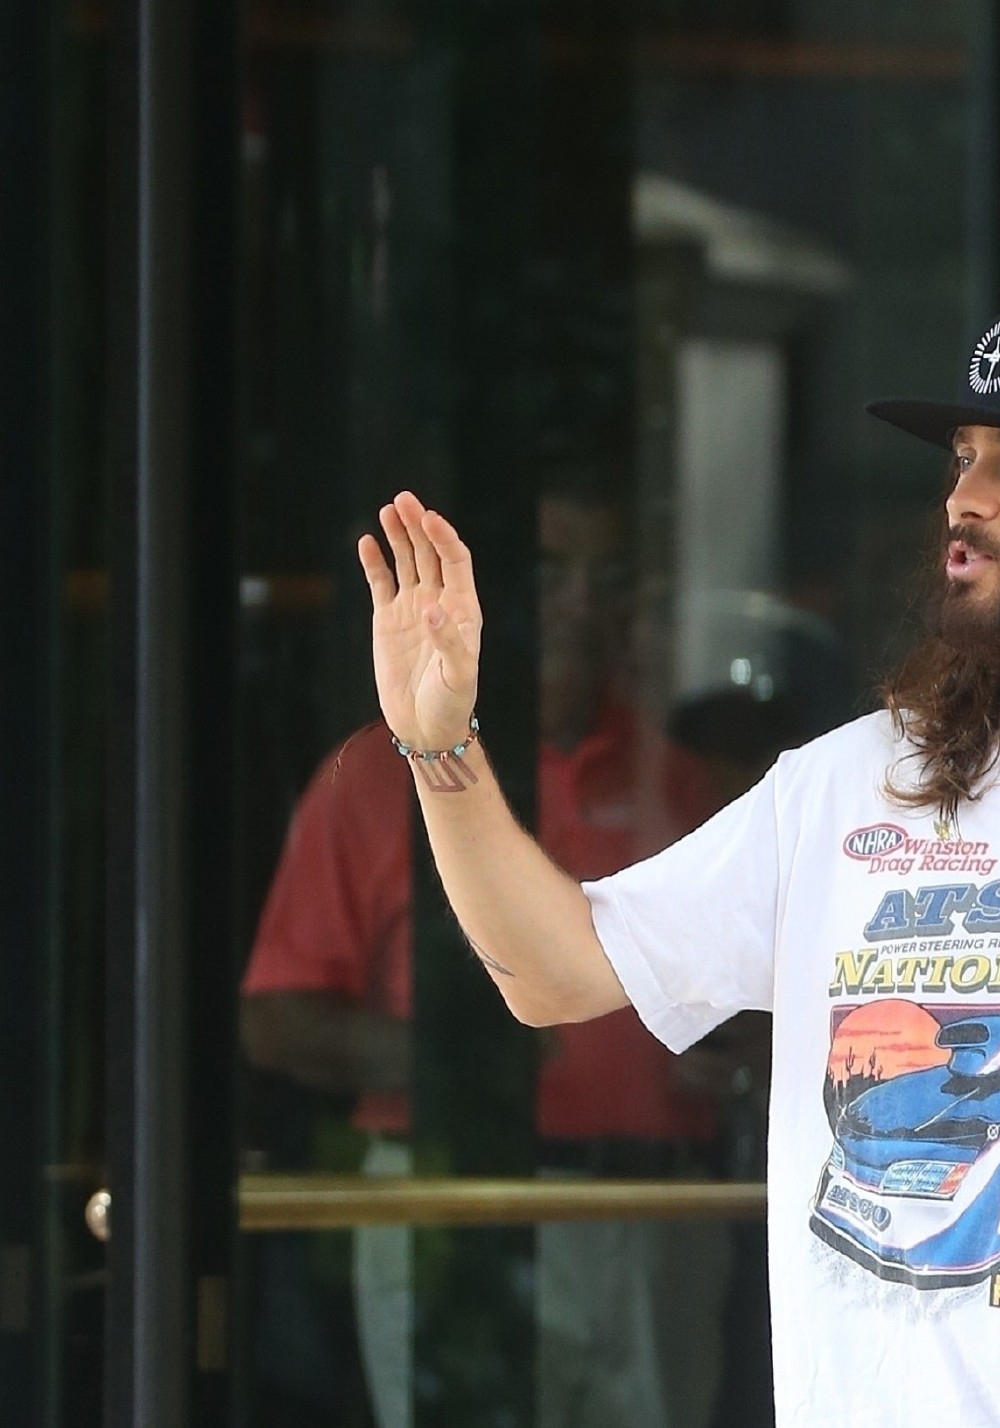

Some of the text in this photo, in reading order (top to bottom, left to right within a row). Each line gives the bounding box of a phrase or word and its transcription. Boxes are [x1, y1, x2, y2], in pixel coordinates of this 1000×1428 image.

[852, 829, 990, 856] NHRA Winston
[868, 855, 998, 876] Drag Racing
[880, 943, 918, 956] POWER
[919, 938, 984, 952] STEERING
